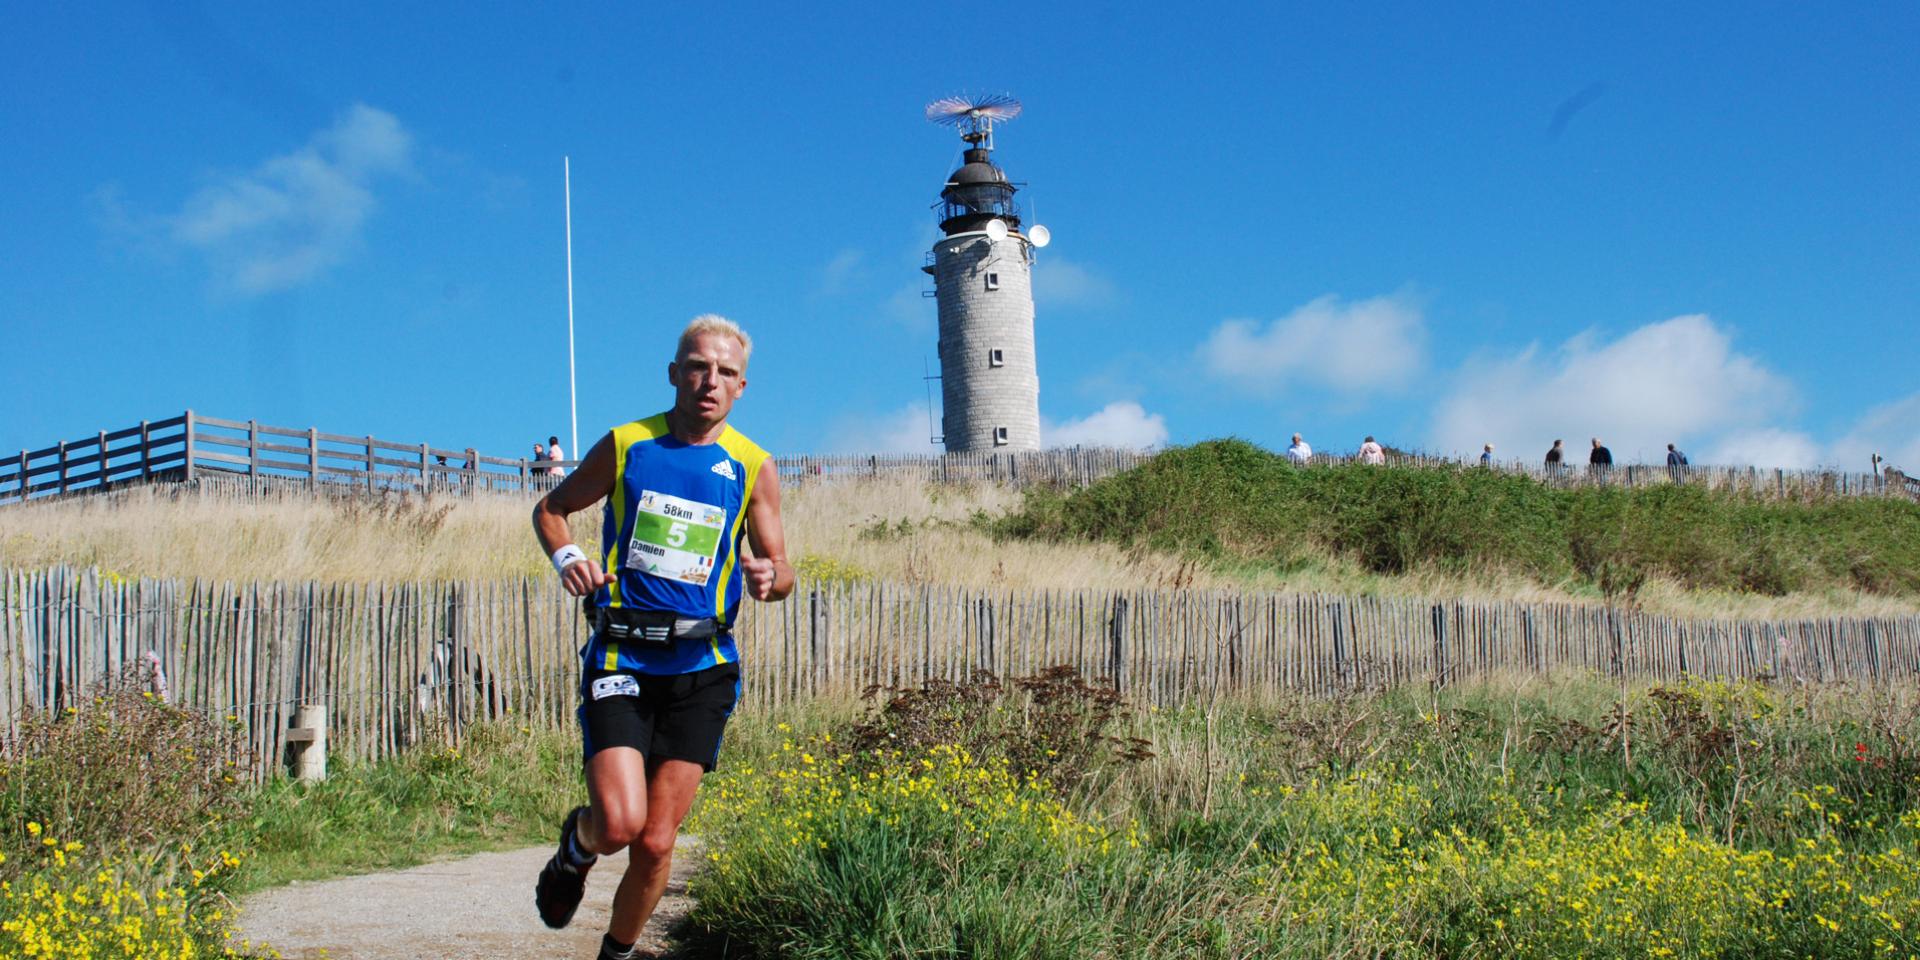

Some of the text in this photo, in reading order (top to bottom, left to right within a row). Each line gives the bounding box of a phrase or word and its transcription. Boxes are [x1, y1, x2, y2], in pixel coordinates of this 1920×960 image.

[663, 504, 693, 520] 58km
[666, 521, 688, 548] 5
[631, 540, 665, 557] Damien
